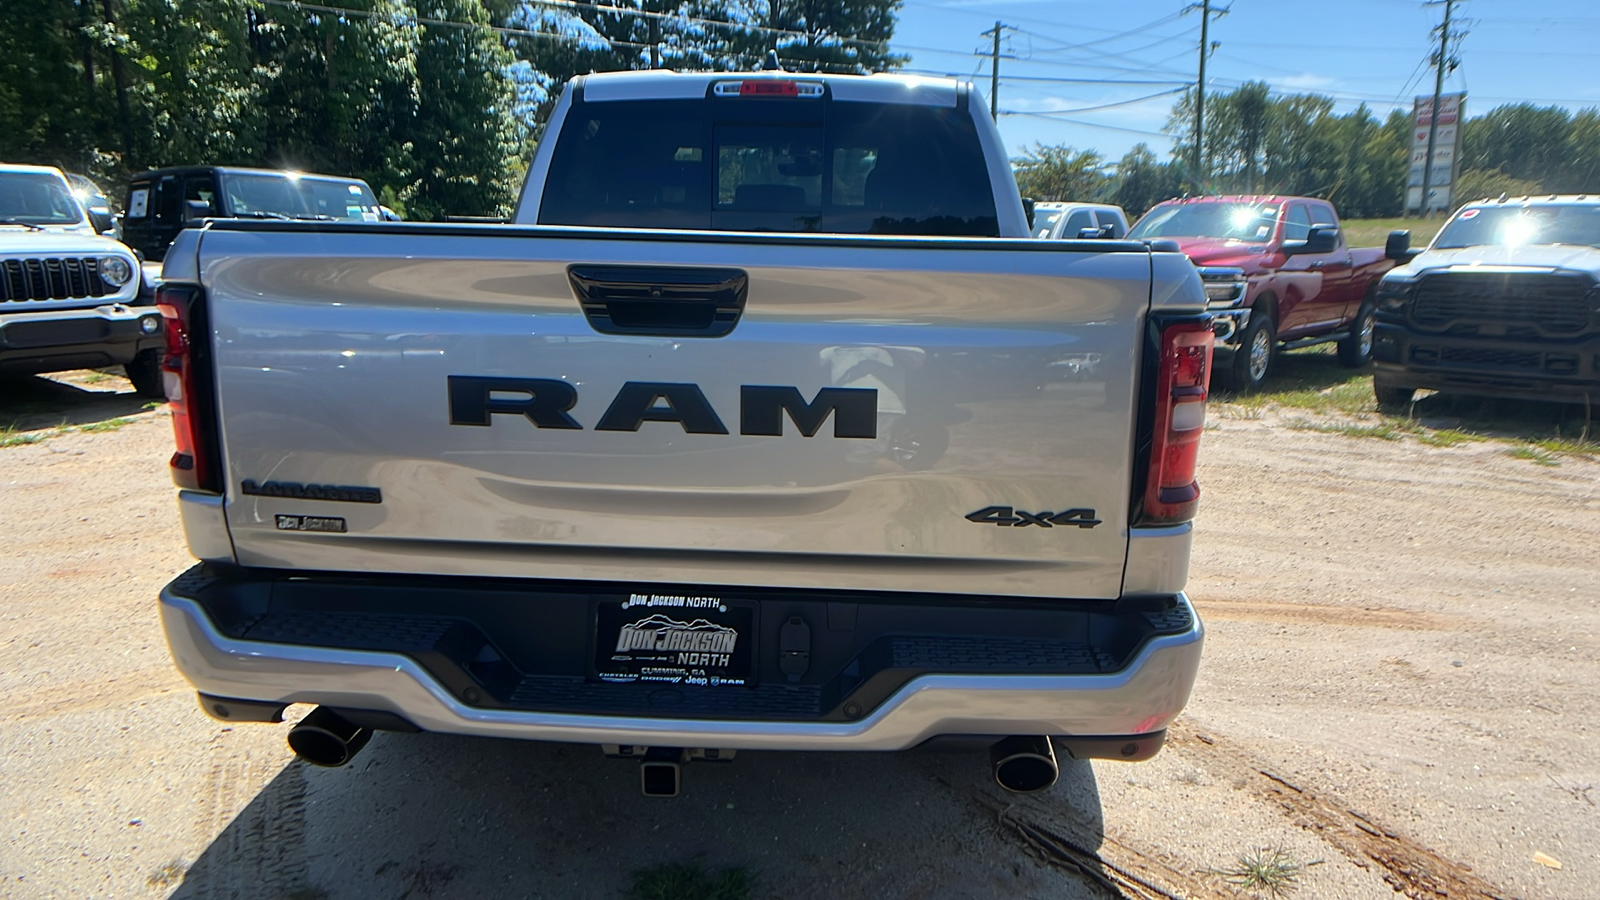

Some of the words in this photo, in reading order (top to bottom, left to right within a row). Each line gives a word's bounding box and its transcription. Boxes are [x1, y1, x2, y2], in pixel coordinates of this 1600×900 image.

[447, 374, 879, 439] RAM
[686, 596, 720, 609] NORTH
[677, 652, 730, 667] NORTH
[685, 675, 708, 686] Jeep
